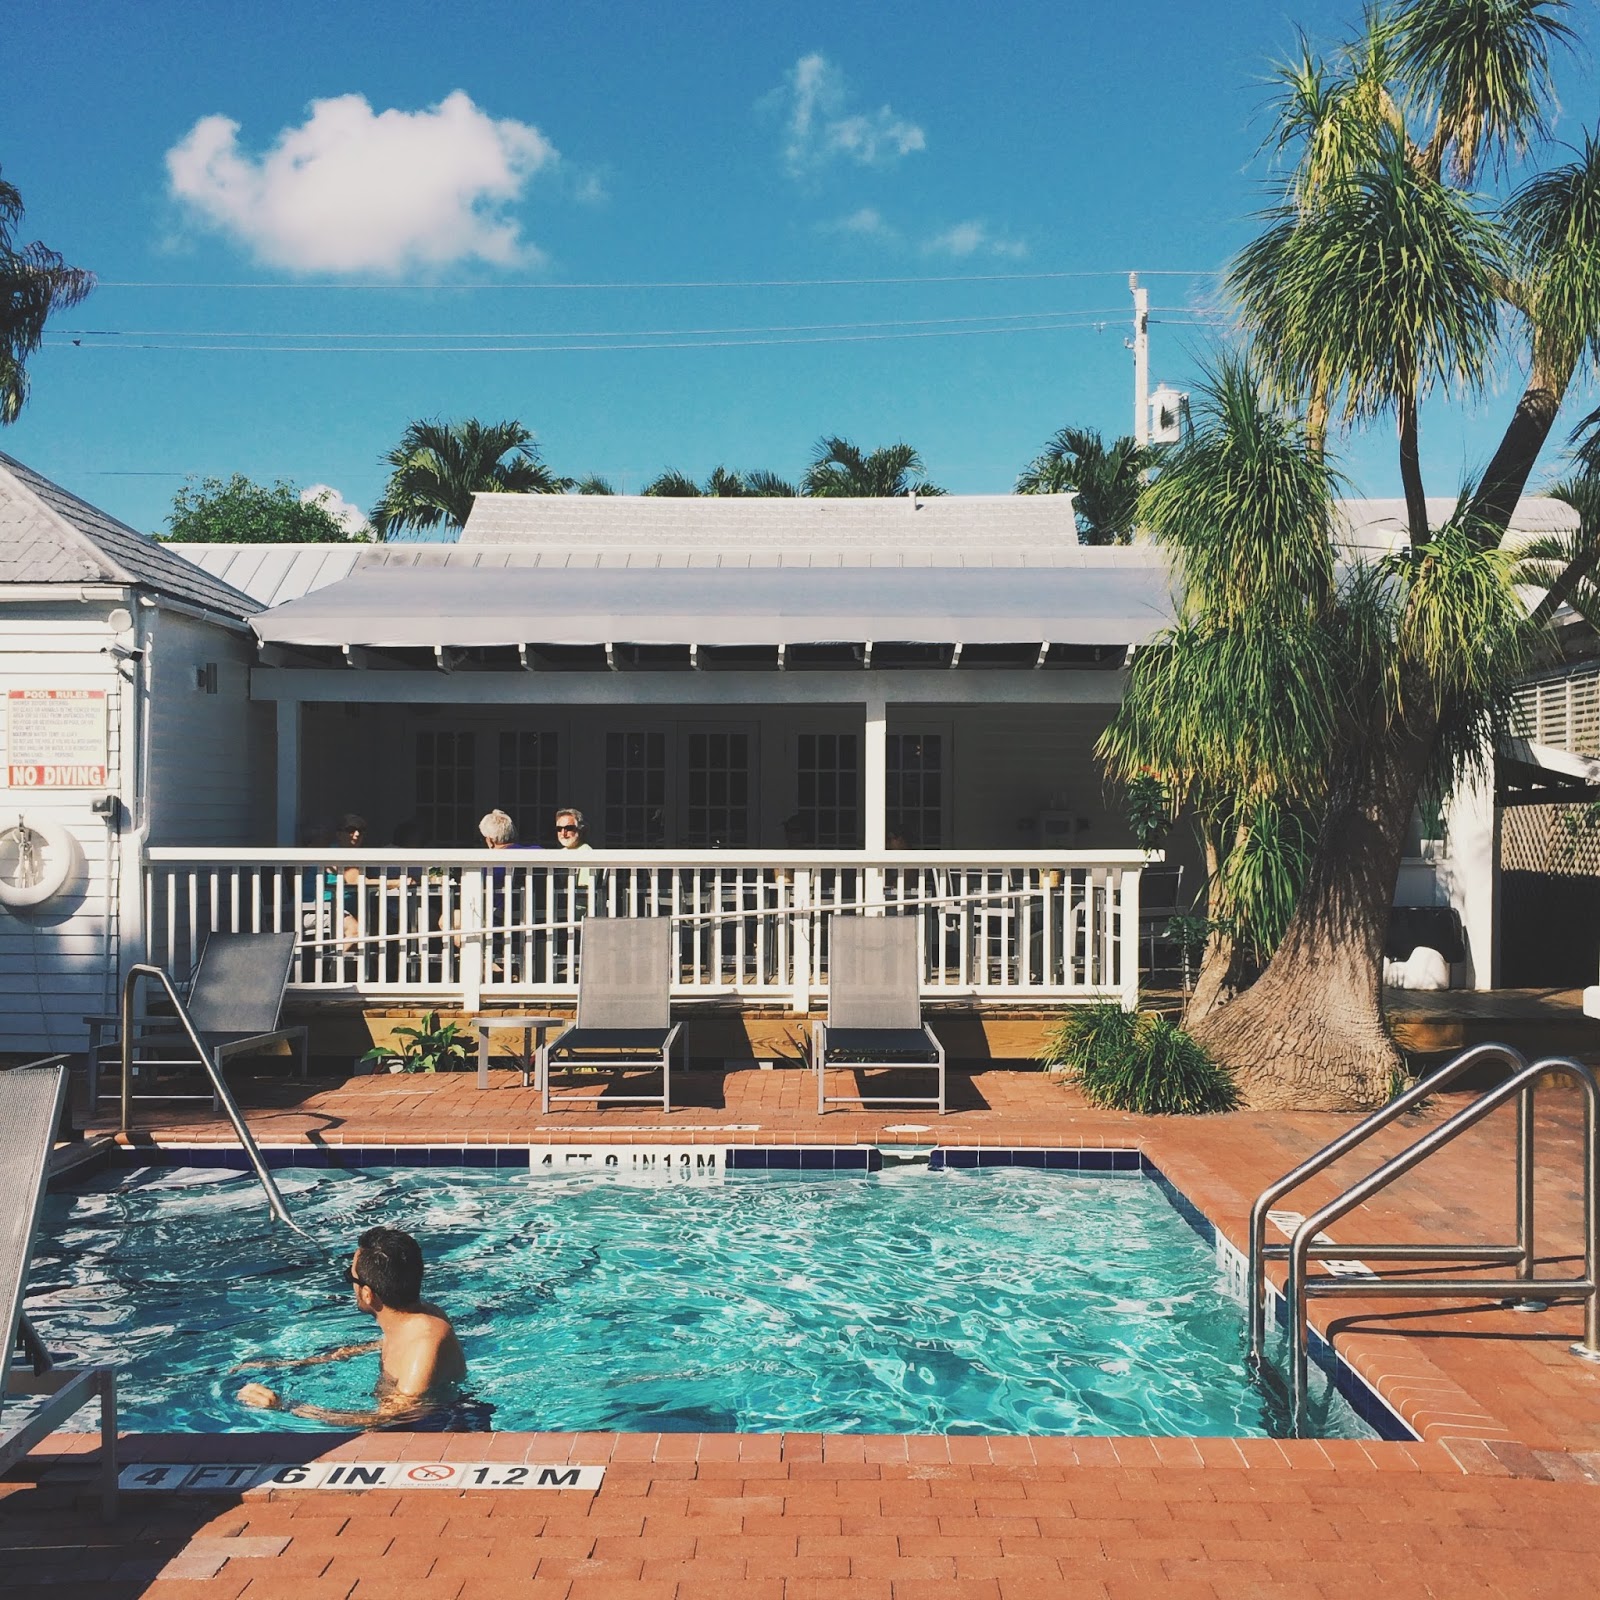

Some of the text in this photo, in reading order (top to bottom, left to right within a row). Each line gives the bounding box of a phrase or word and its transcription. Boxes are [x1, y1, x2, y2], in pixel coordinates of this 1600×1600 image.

[24, 691, 89, 699] POOL RULES
[13, 766, 101, 785] NO DIVING
[134, 1466, 581, 1485] 4 FT 6 IN. 1.2 M
